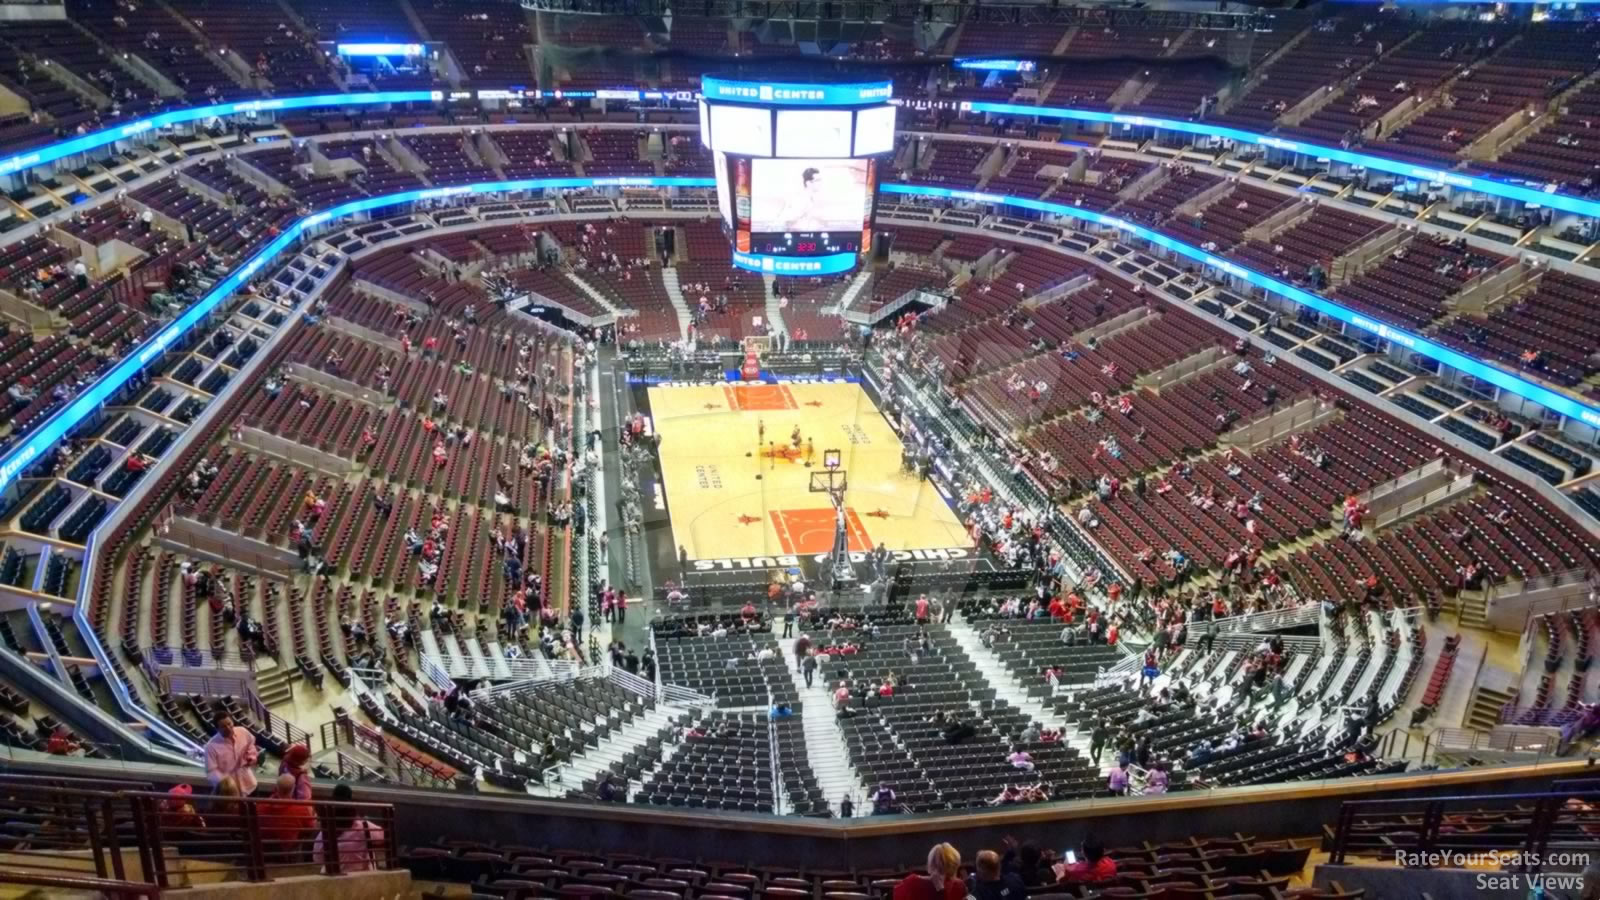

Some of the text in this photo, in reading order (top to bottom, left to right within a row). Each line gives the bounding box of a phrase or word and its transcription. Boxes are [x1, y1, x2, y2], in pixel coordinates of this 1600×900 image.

[719, 85, 824, 99] UNITED CENTER
[775, 261, 822, 271] CENTER
[7, 446, 35, 475] CENTER
[694, 555, 798, 570] BULLS
